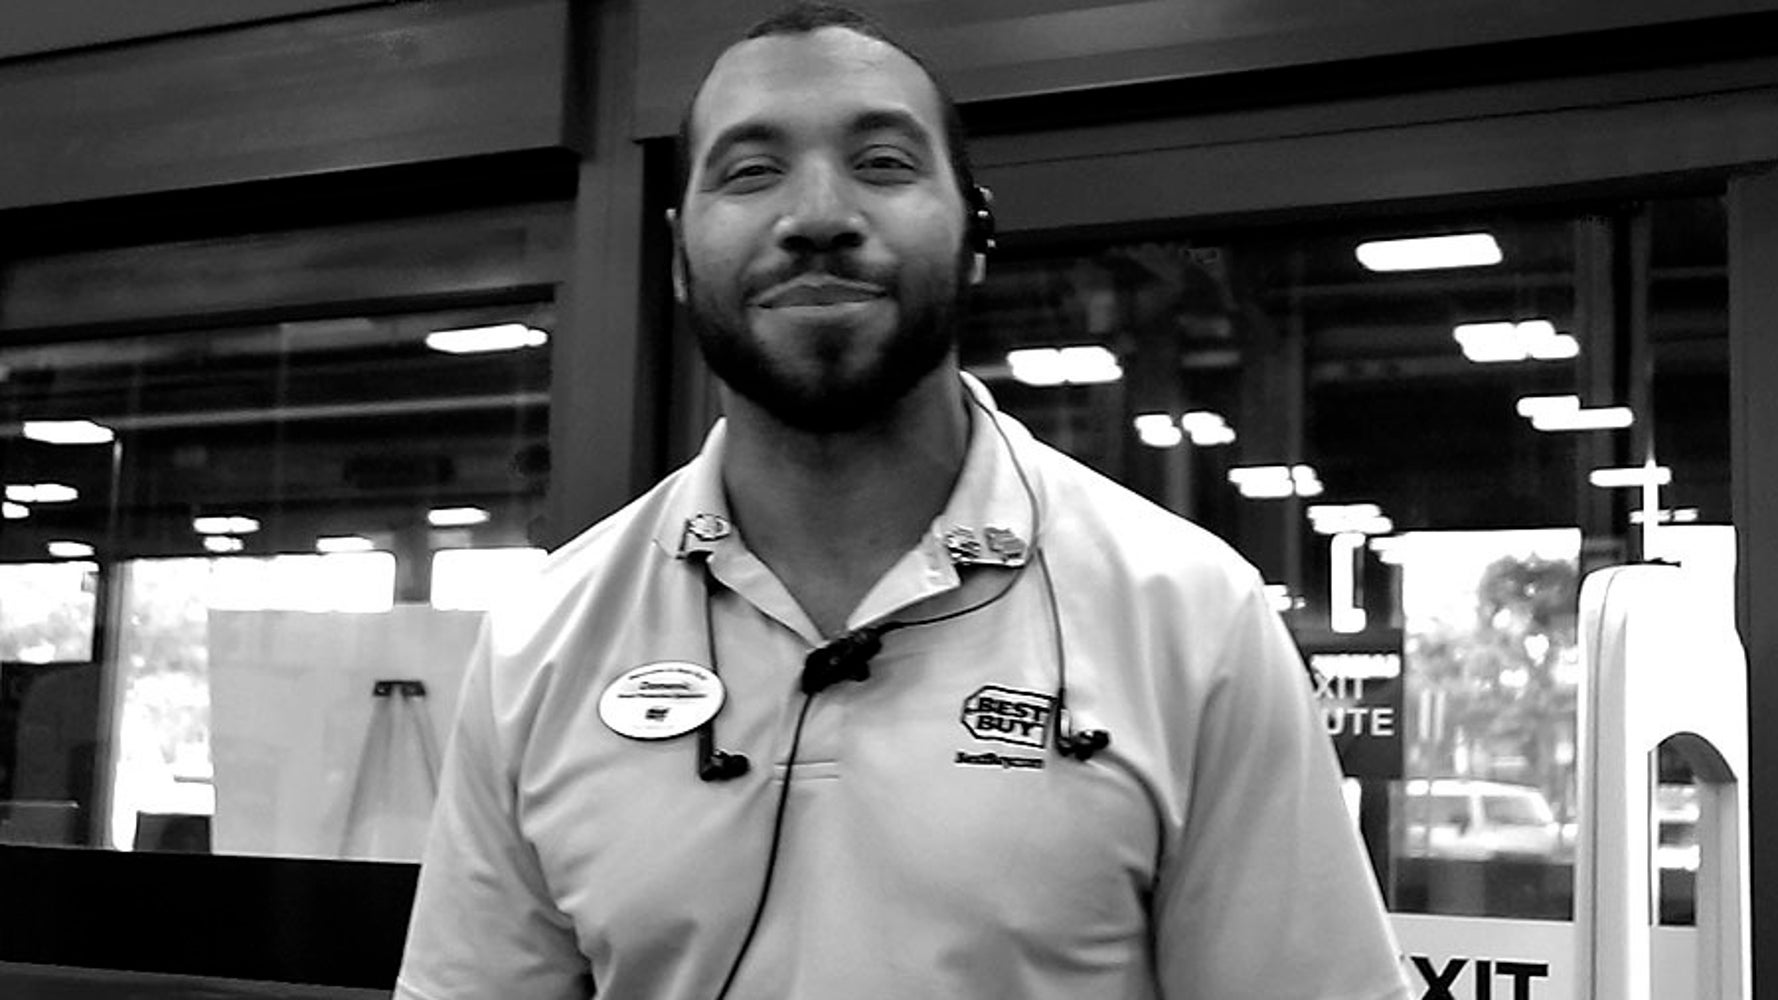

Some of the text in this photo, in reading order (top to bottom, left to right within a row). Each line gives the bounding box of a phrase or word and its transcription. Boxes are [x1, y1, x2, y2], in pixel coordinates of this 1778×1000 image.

[1312, 670, 1363, 699] XIT
[978, 697, 1050, 721] BEST
[1321, 707, 1394, 736] UTE
[976, 715, 1045, 736] BUY
[1406, 956, 1549, 1000] XIT
